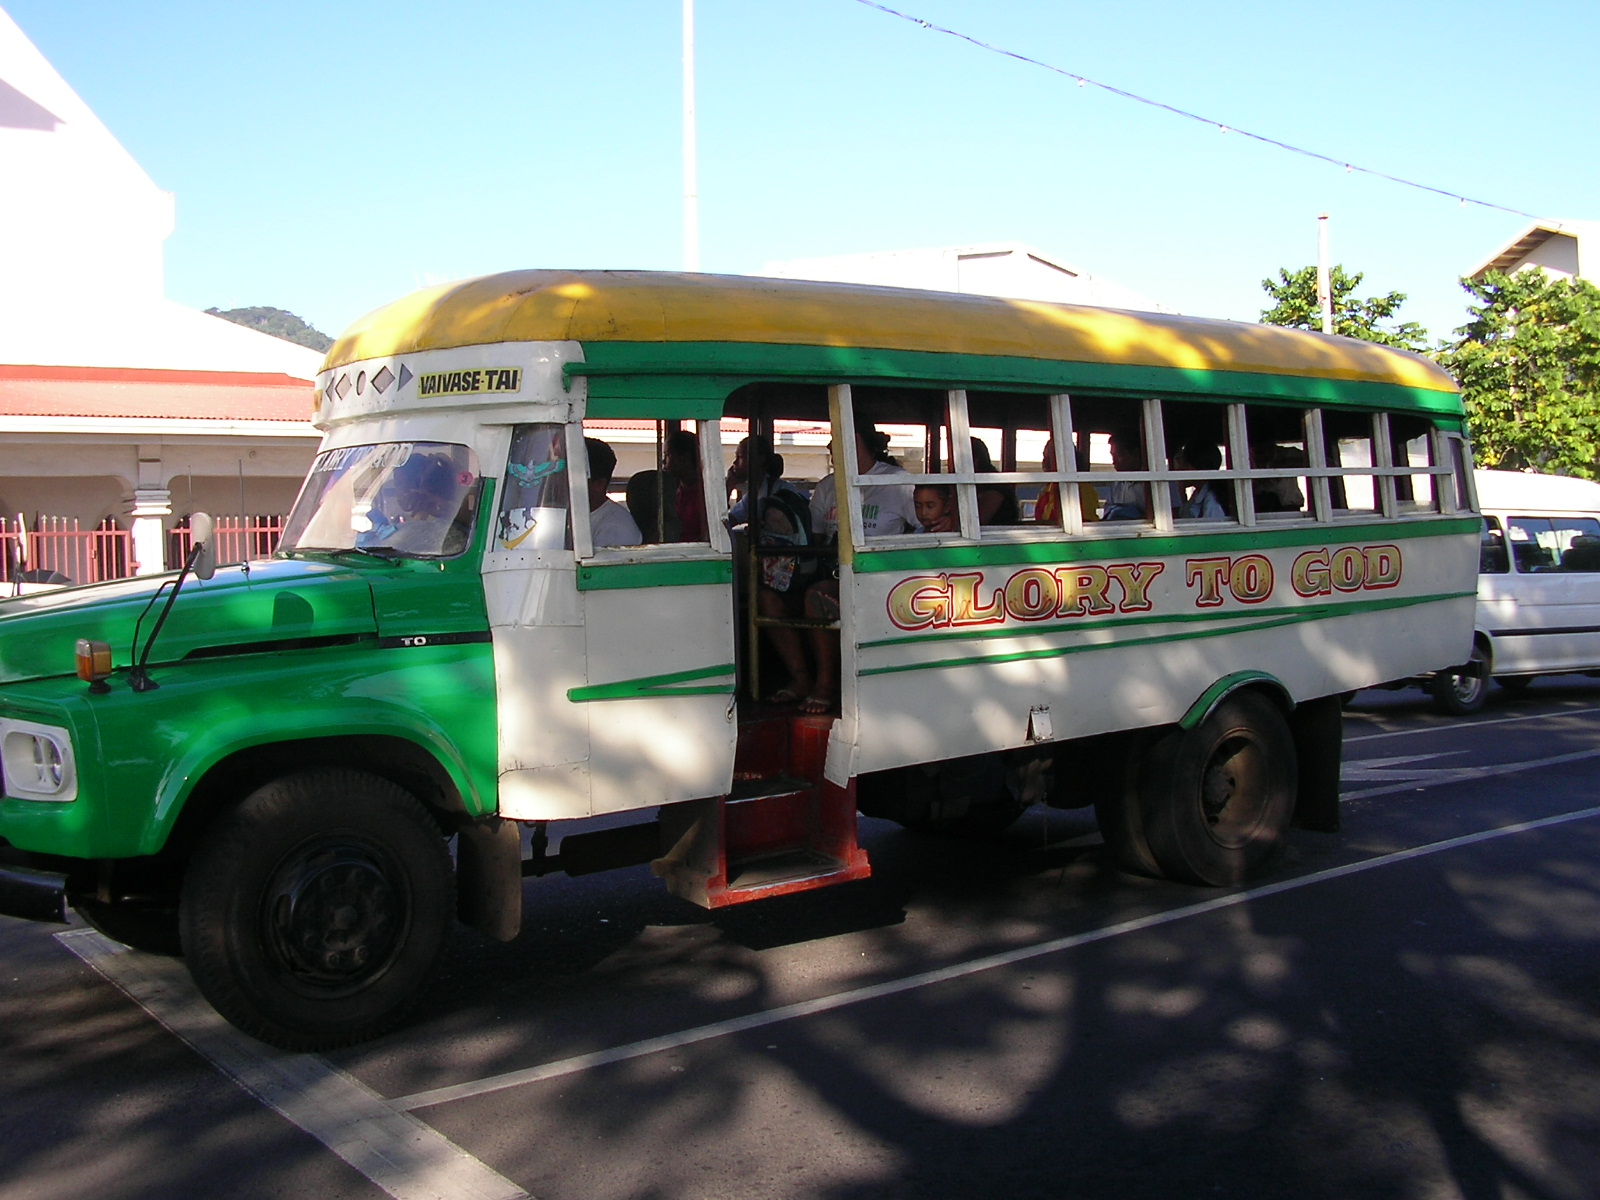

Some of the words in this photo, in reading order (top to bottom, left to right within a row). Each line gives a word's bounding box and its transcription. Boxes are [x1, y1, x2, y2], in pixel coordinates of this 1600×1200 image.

[420, 369, 518, 395] VAIVASE-TAI
[887, 562, 1165, 631] GLORY
[1186, 554, 1275, 607] TO
[1291, 544, 1403, 597] GOD
